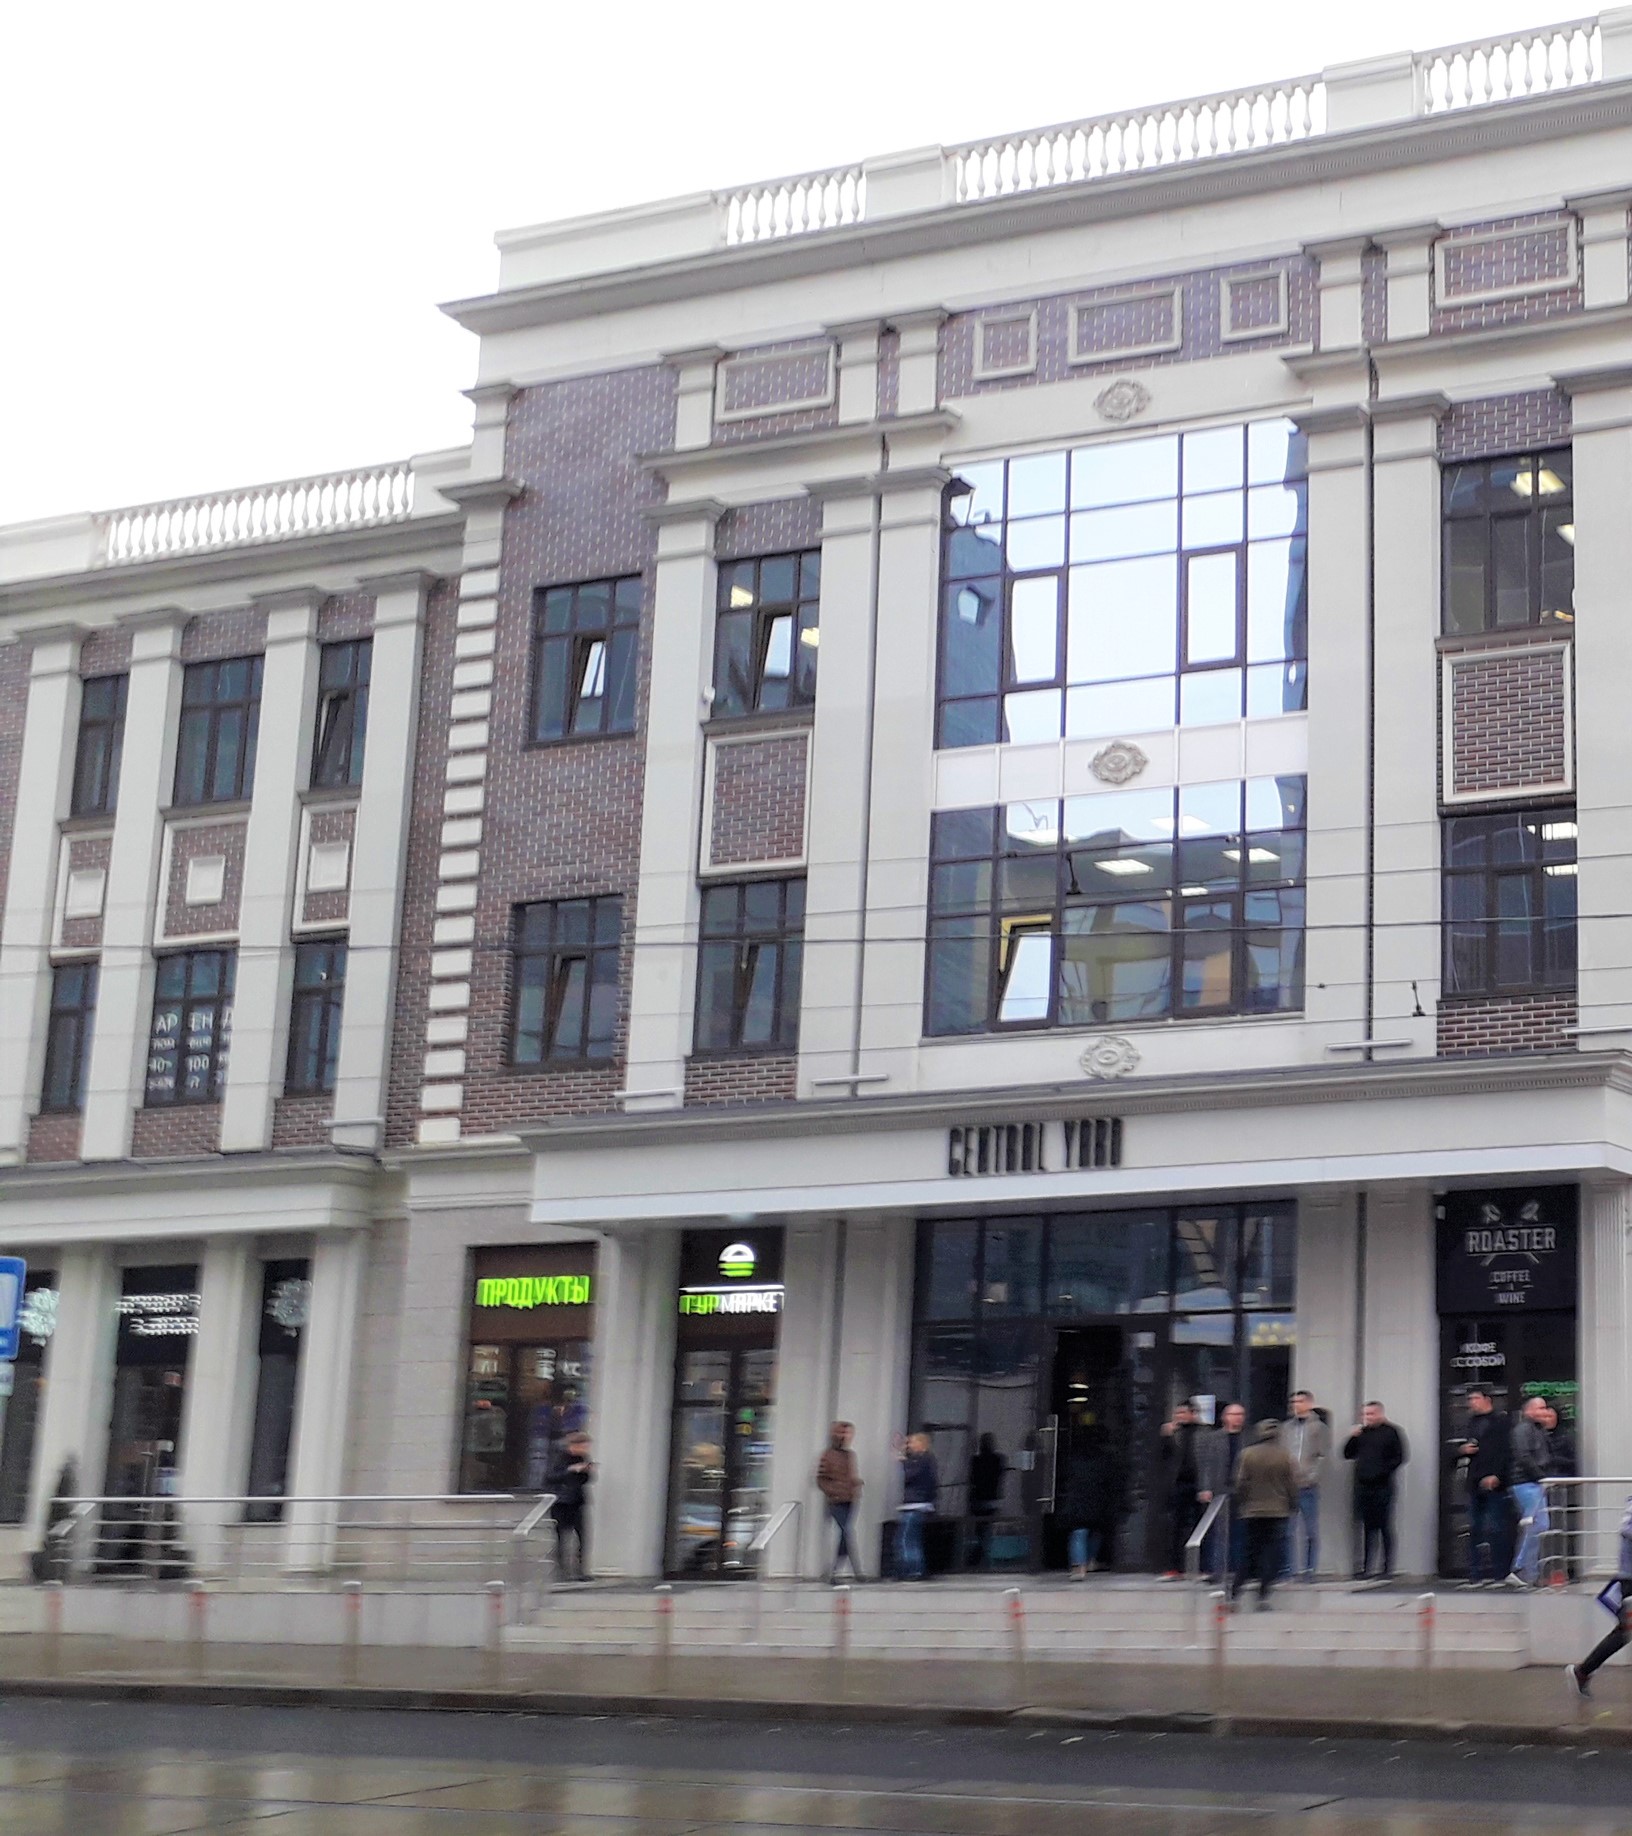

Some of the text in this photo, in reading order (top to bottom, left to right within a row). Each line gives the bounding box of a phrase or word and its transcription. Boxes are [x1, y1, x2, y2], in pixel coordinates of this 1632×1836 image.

[949, 1116, 1122, 1177] CENTRAL YARD
[1466, 1227, 1556, 1253] ROASTER
[477, 1275, 590, 1309] ПРОДУКТЫ
